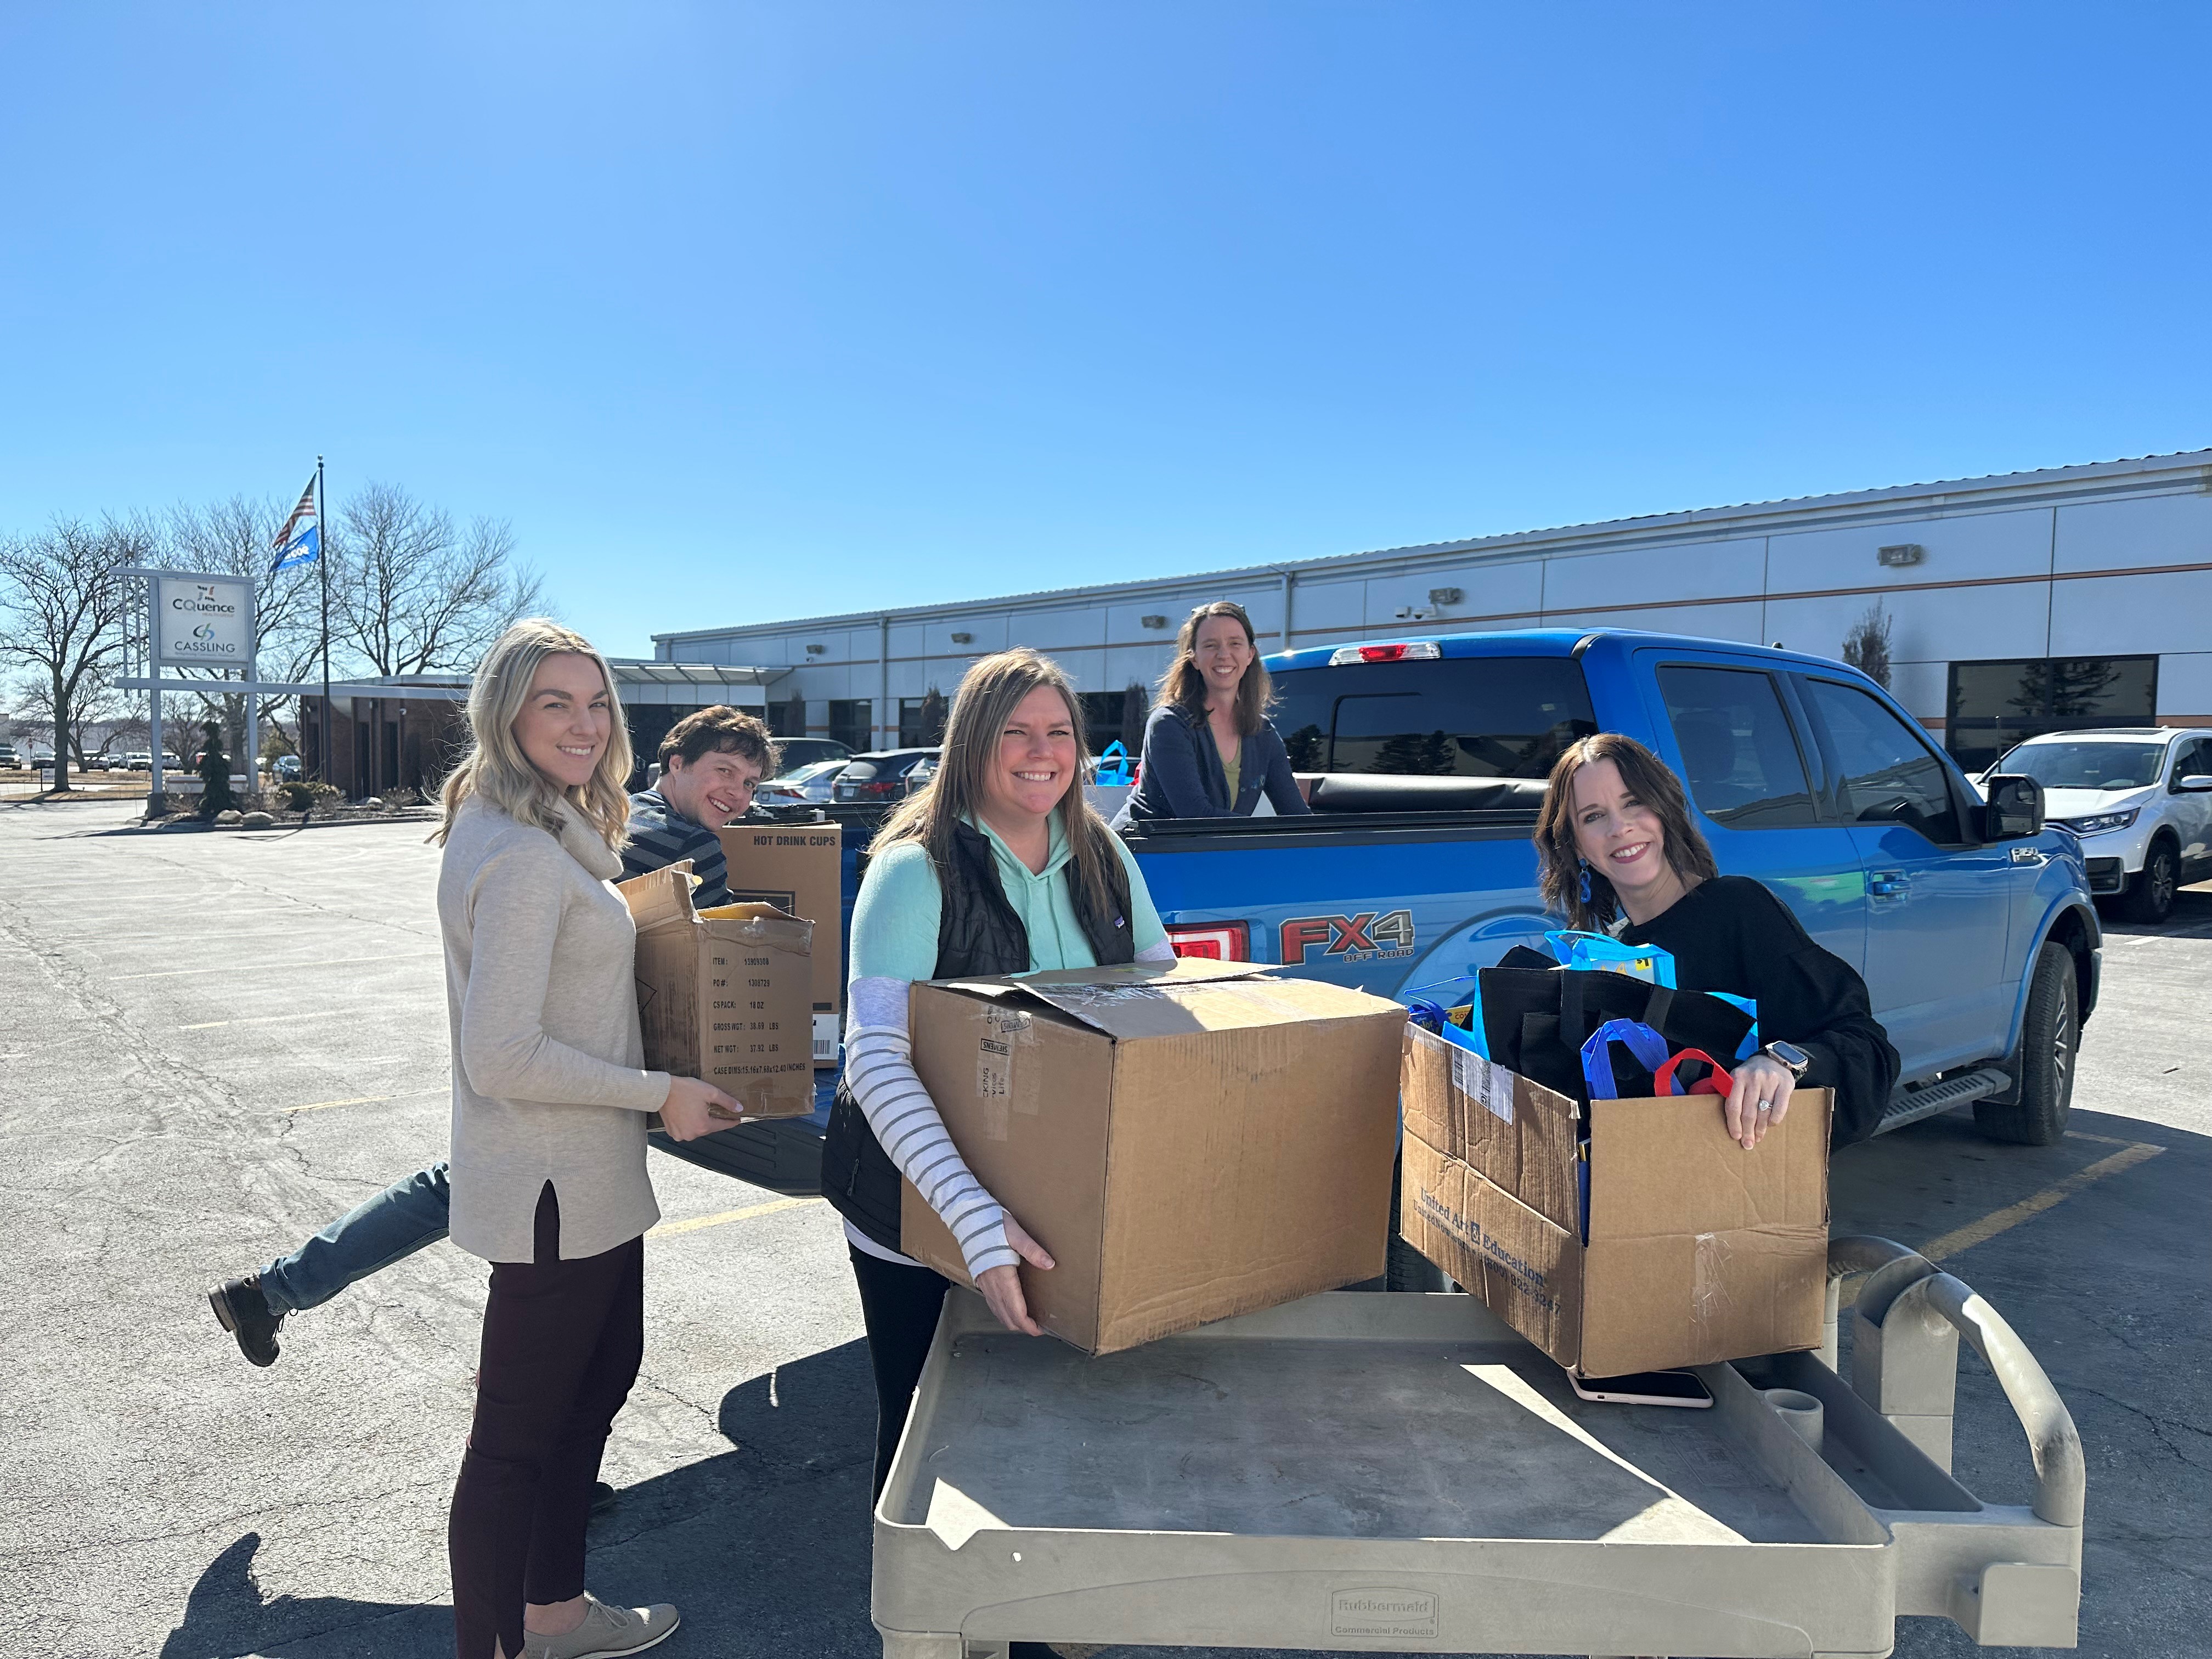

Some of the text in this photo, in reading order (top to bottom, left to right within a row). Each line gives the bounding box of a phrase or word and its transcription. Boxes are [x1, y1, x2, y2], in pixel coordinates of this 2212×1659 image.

[173, 599, 235, 613] CQuence
[174, 641, 235, 653] CASSLING
[754, 836, 836, 846] HOT DRINK CUPS
[1279, 909, 1415, 966] FX4
[1344, 948, 1414, 963] OFF ROAD
[983, 1041, 1008, 1053] SIEMENS
[714, 1066, 727, 1075] CASE
[1421, 1187, 1449, 1221] United
[1452, 1212, 1469, 1235] Art
[1482, 1234, 1544, 1288] Education
[1335, 1626, 1434, 1635] Commercial Products
